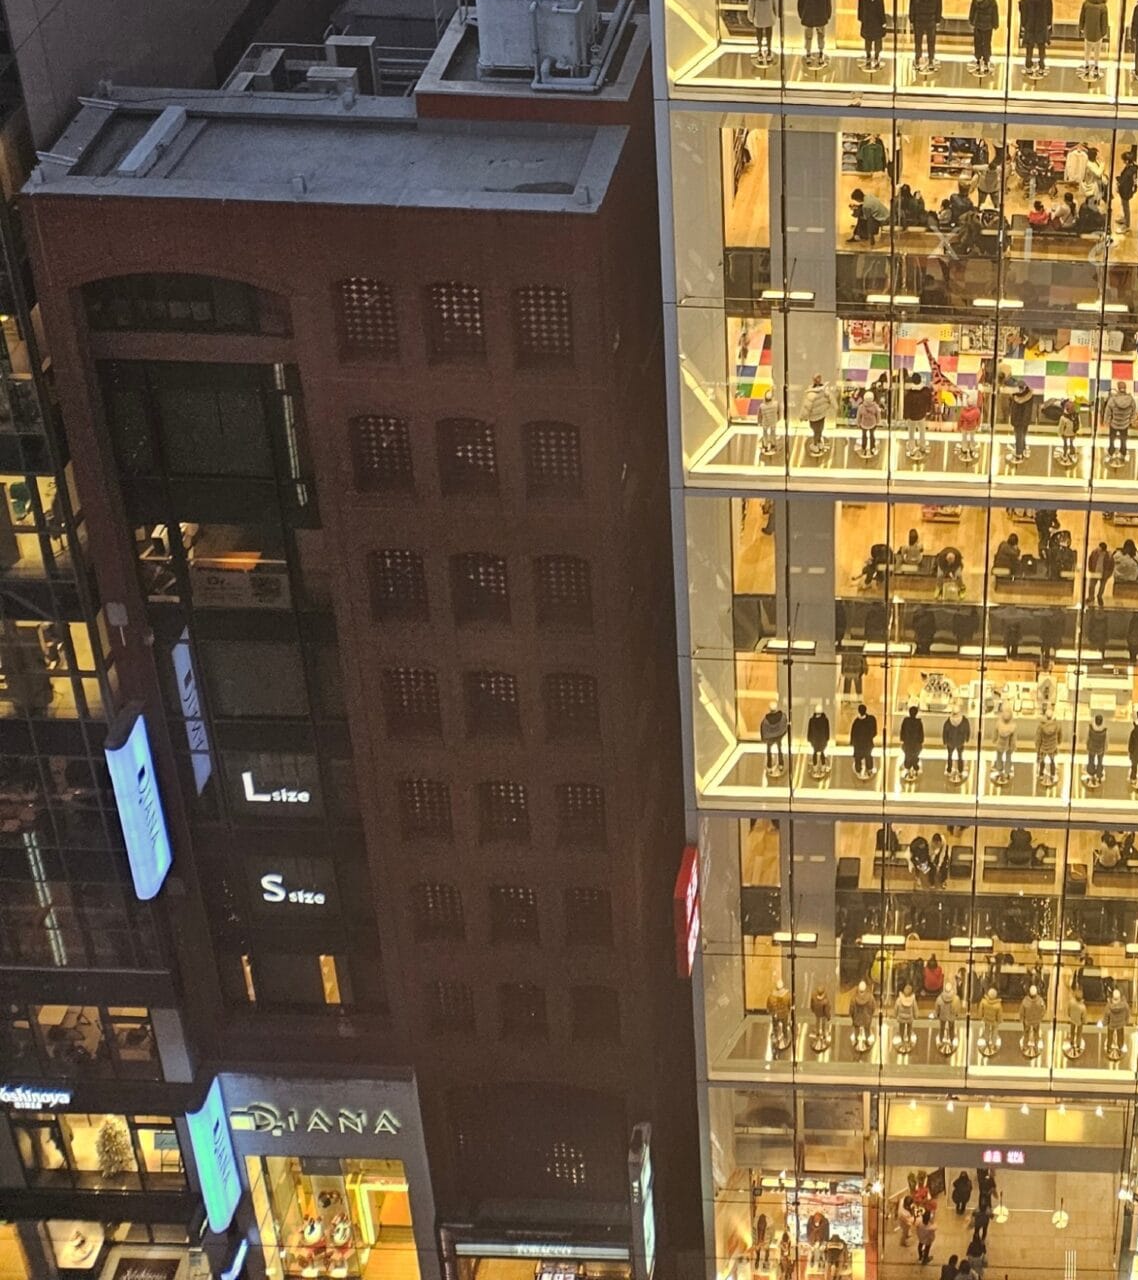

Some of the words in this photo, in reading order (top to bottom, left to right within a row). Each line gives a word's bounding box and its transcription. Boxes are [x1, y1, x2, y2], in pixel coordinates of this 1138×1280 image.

[242, 771, 271, 802] L
[271, 788, 310, 803] size
[261, 874, 286, 902] S
[288, 889, 326, 905] size
[252, 1102, 402, 1137] DIANA
